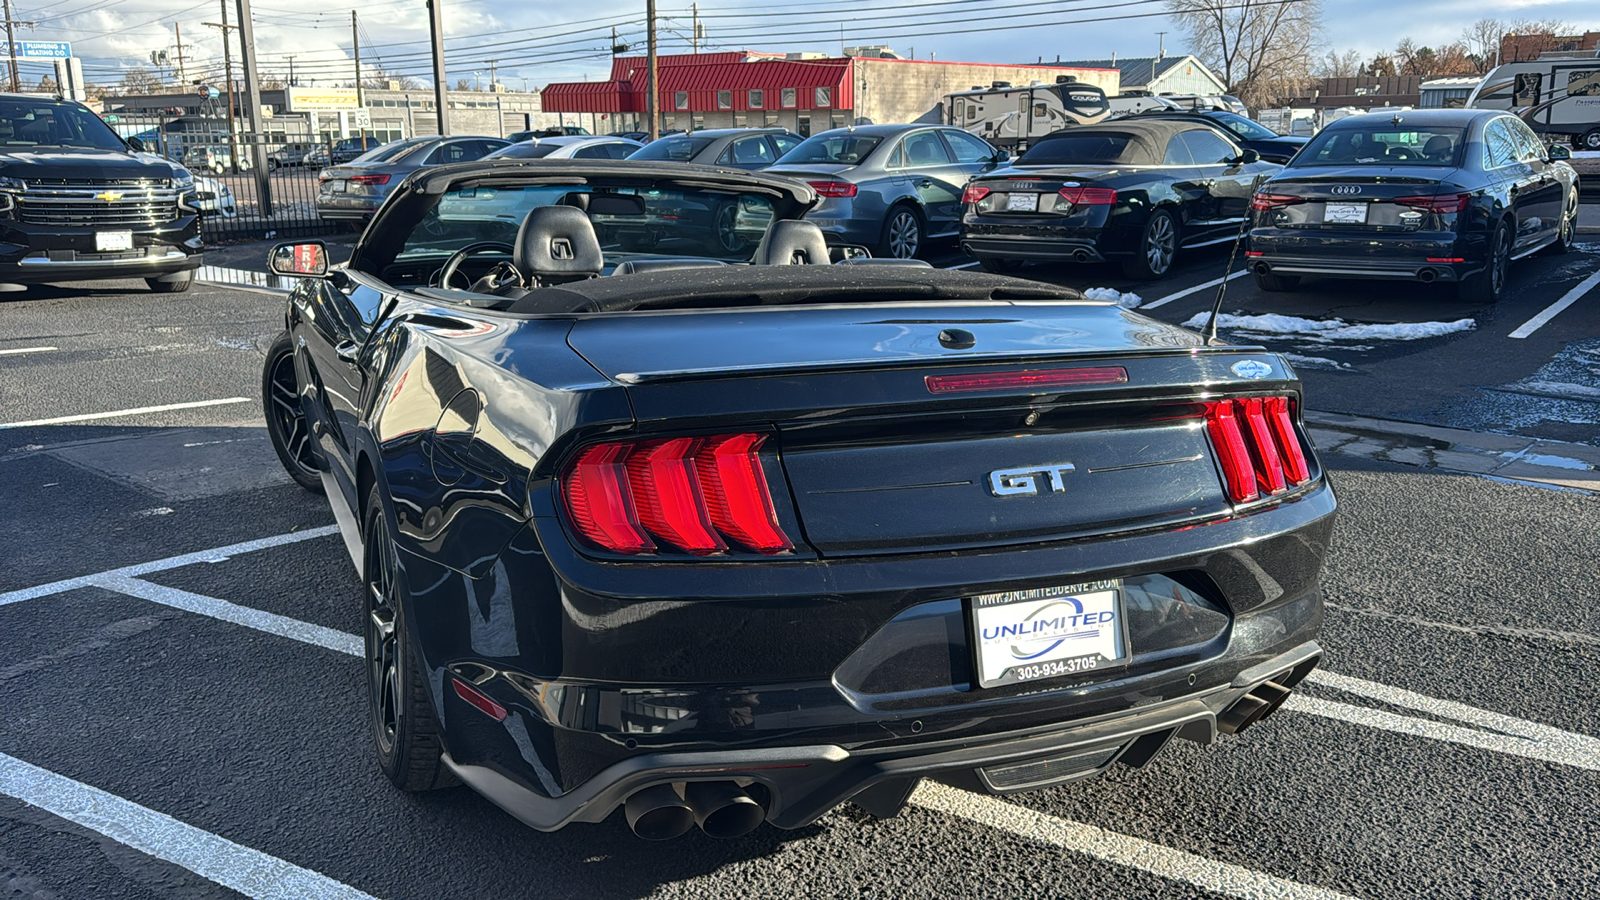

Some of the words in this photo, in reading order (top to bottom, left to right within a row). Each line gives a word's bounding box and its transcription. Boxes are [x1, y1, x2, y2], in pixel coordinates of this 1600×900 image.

[358, 118, 369, 126] 30
[988, 464, 1075, 497] GT
[983, 611, 1115, 640] UNLIMITED
[984, 635, 1022, 645] AUTO
[1033, 627, 1079, 638] SALES
[1017, 656, 1097, 680] 303-934-3705
